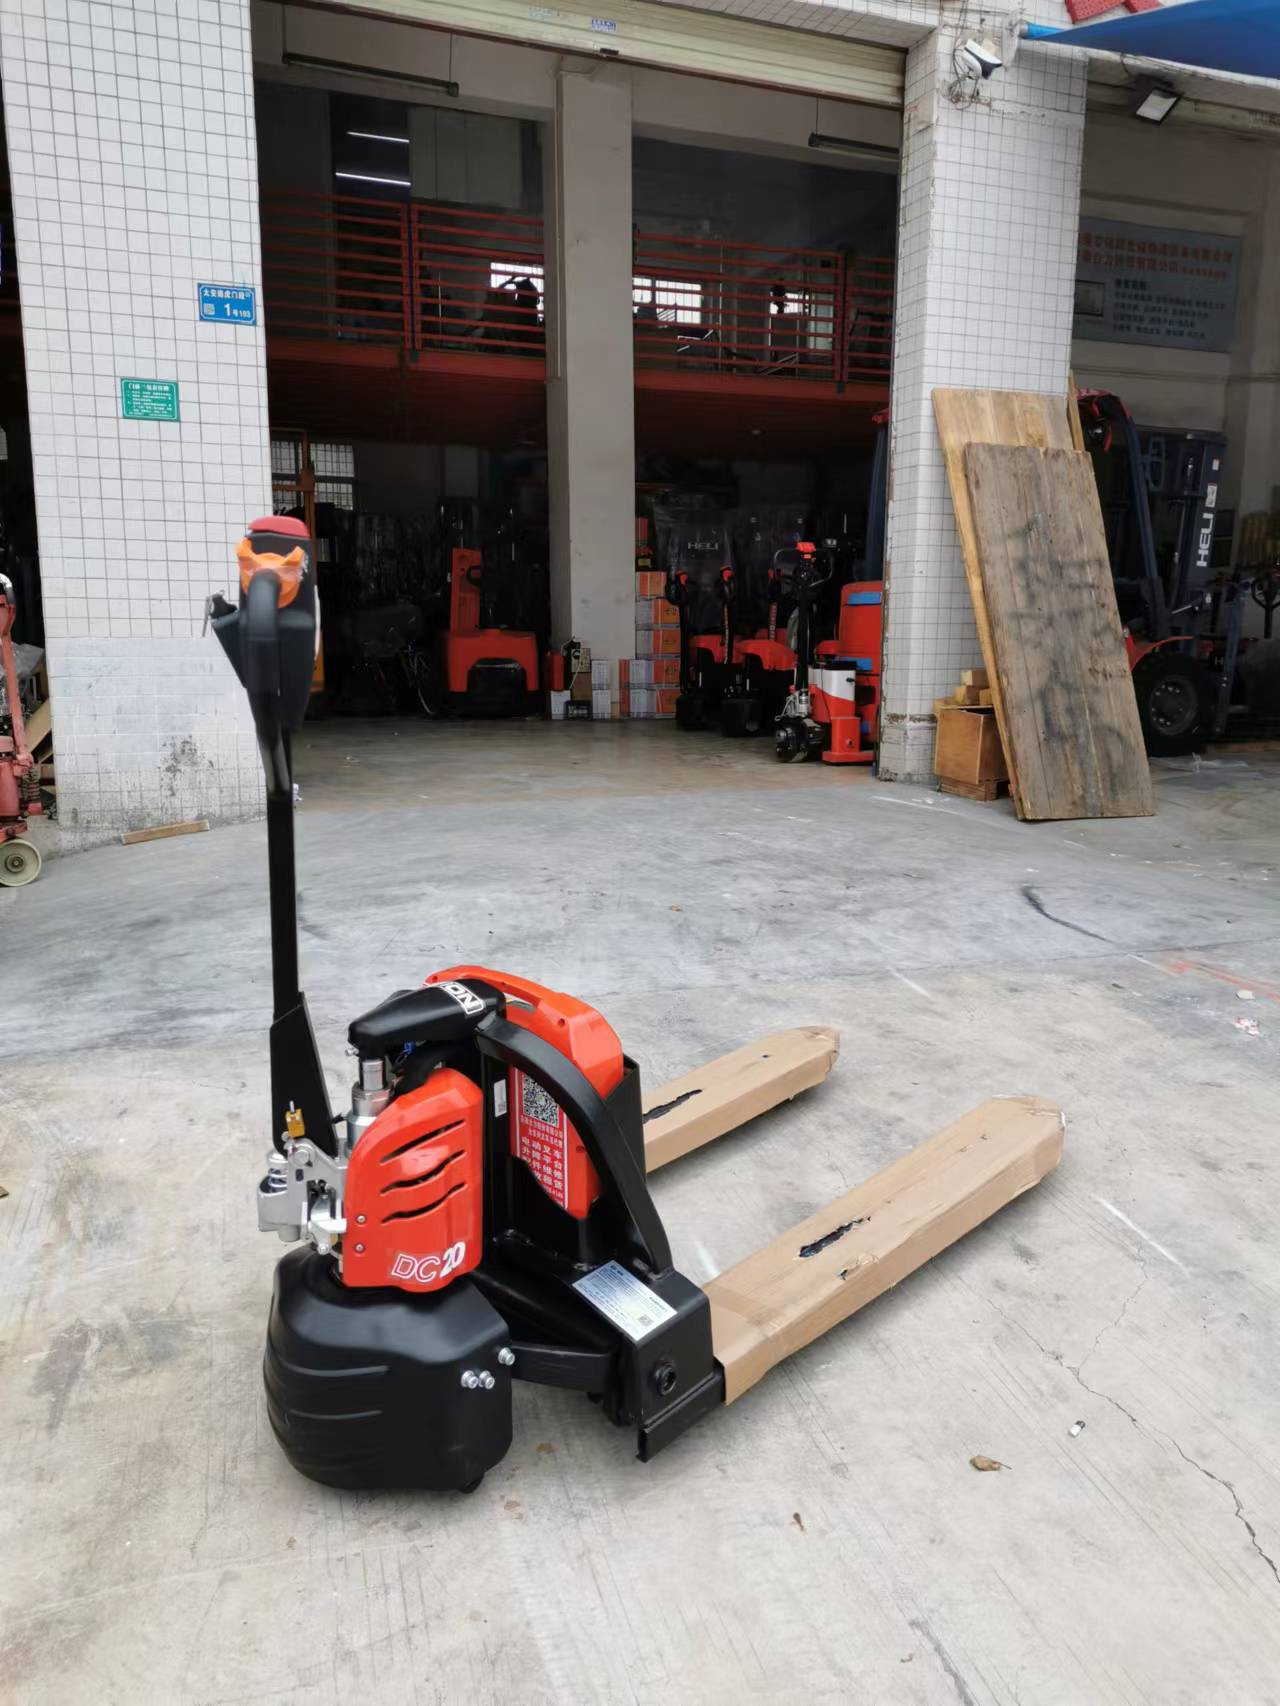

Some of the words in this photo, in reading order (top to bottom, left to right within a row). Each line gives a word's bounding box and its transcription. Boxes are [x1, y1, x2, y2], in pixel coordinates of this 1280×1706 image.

[687, 542, 718, 550] HELI
[1196, 513, 1214, 567] HELI
[521, 1136, 562, 1160] 电动叉车
[522, 1146, 562, 1171] 升降平台
